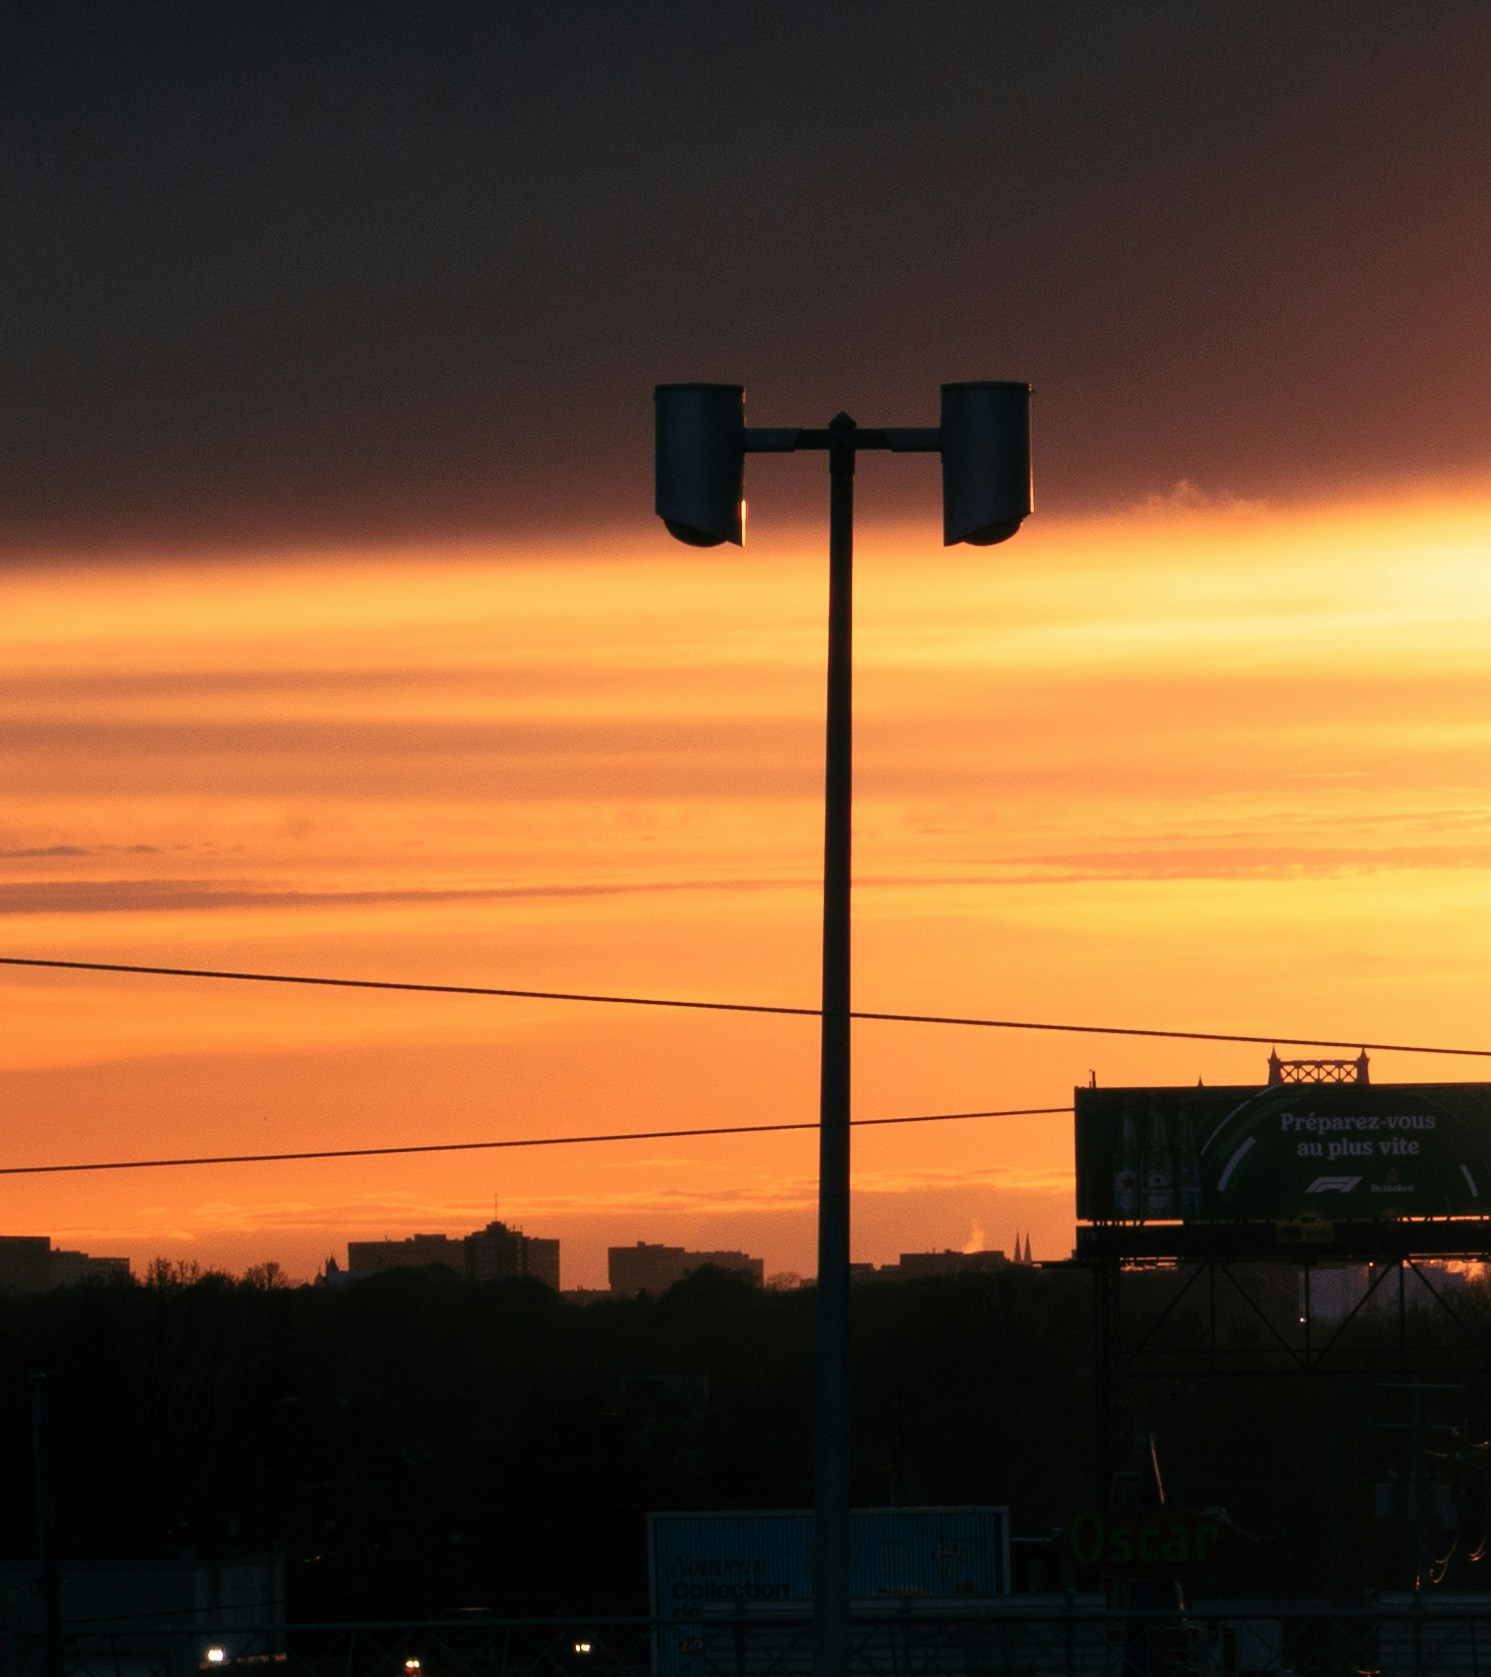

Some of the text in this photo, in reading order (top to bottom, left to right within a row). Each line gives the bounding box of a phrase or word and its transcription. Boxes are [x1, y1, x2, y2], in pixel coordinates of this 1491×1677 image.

[1280, 1111, 1437, 1135] Préparez-vous
[1297, 1136, 1420, 1161] au plus vite
[1070, 1505, 1220, 1565] Oscar
[672, 1554, 767, 1577] Nouveau
[672, 1579, 790, 1600] Collection
